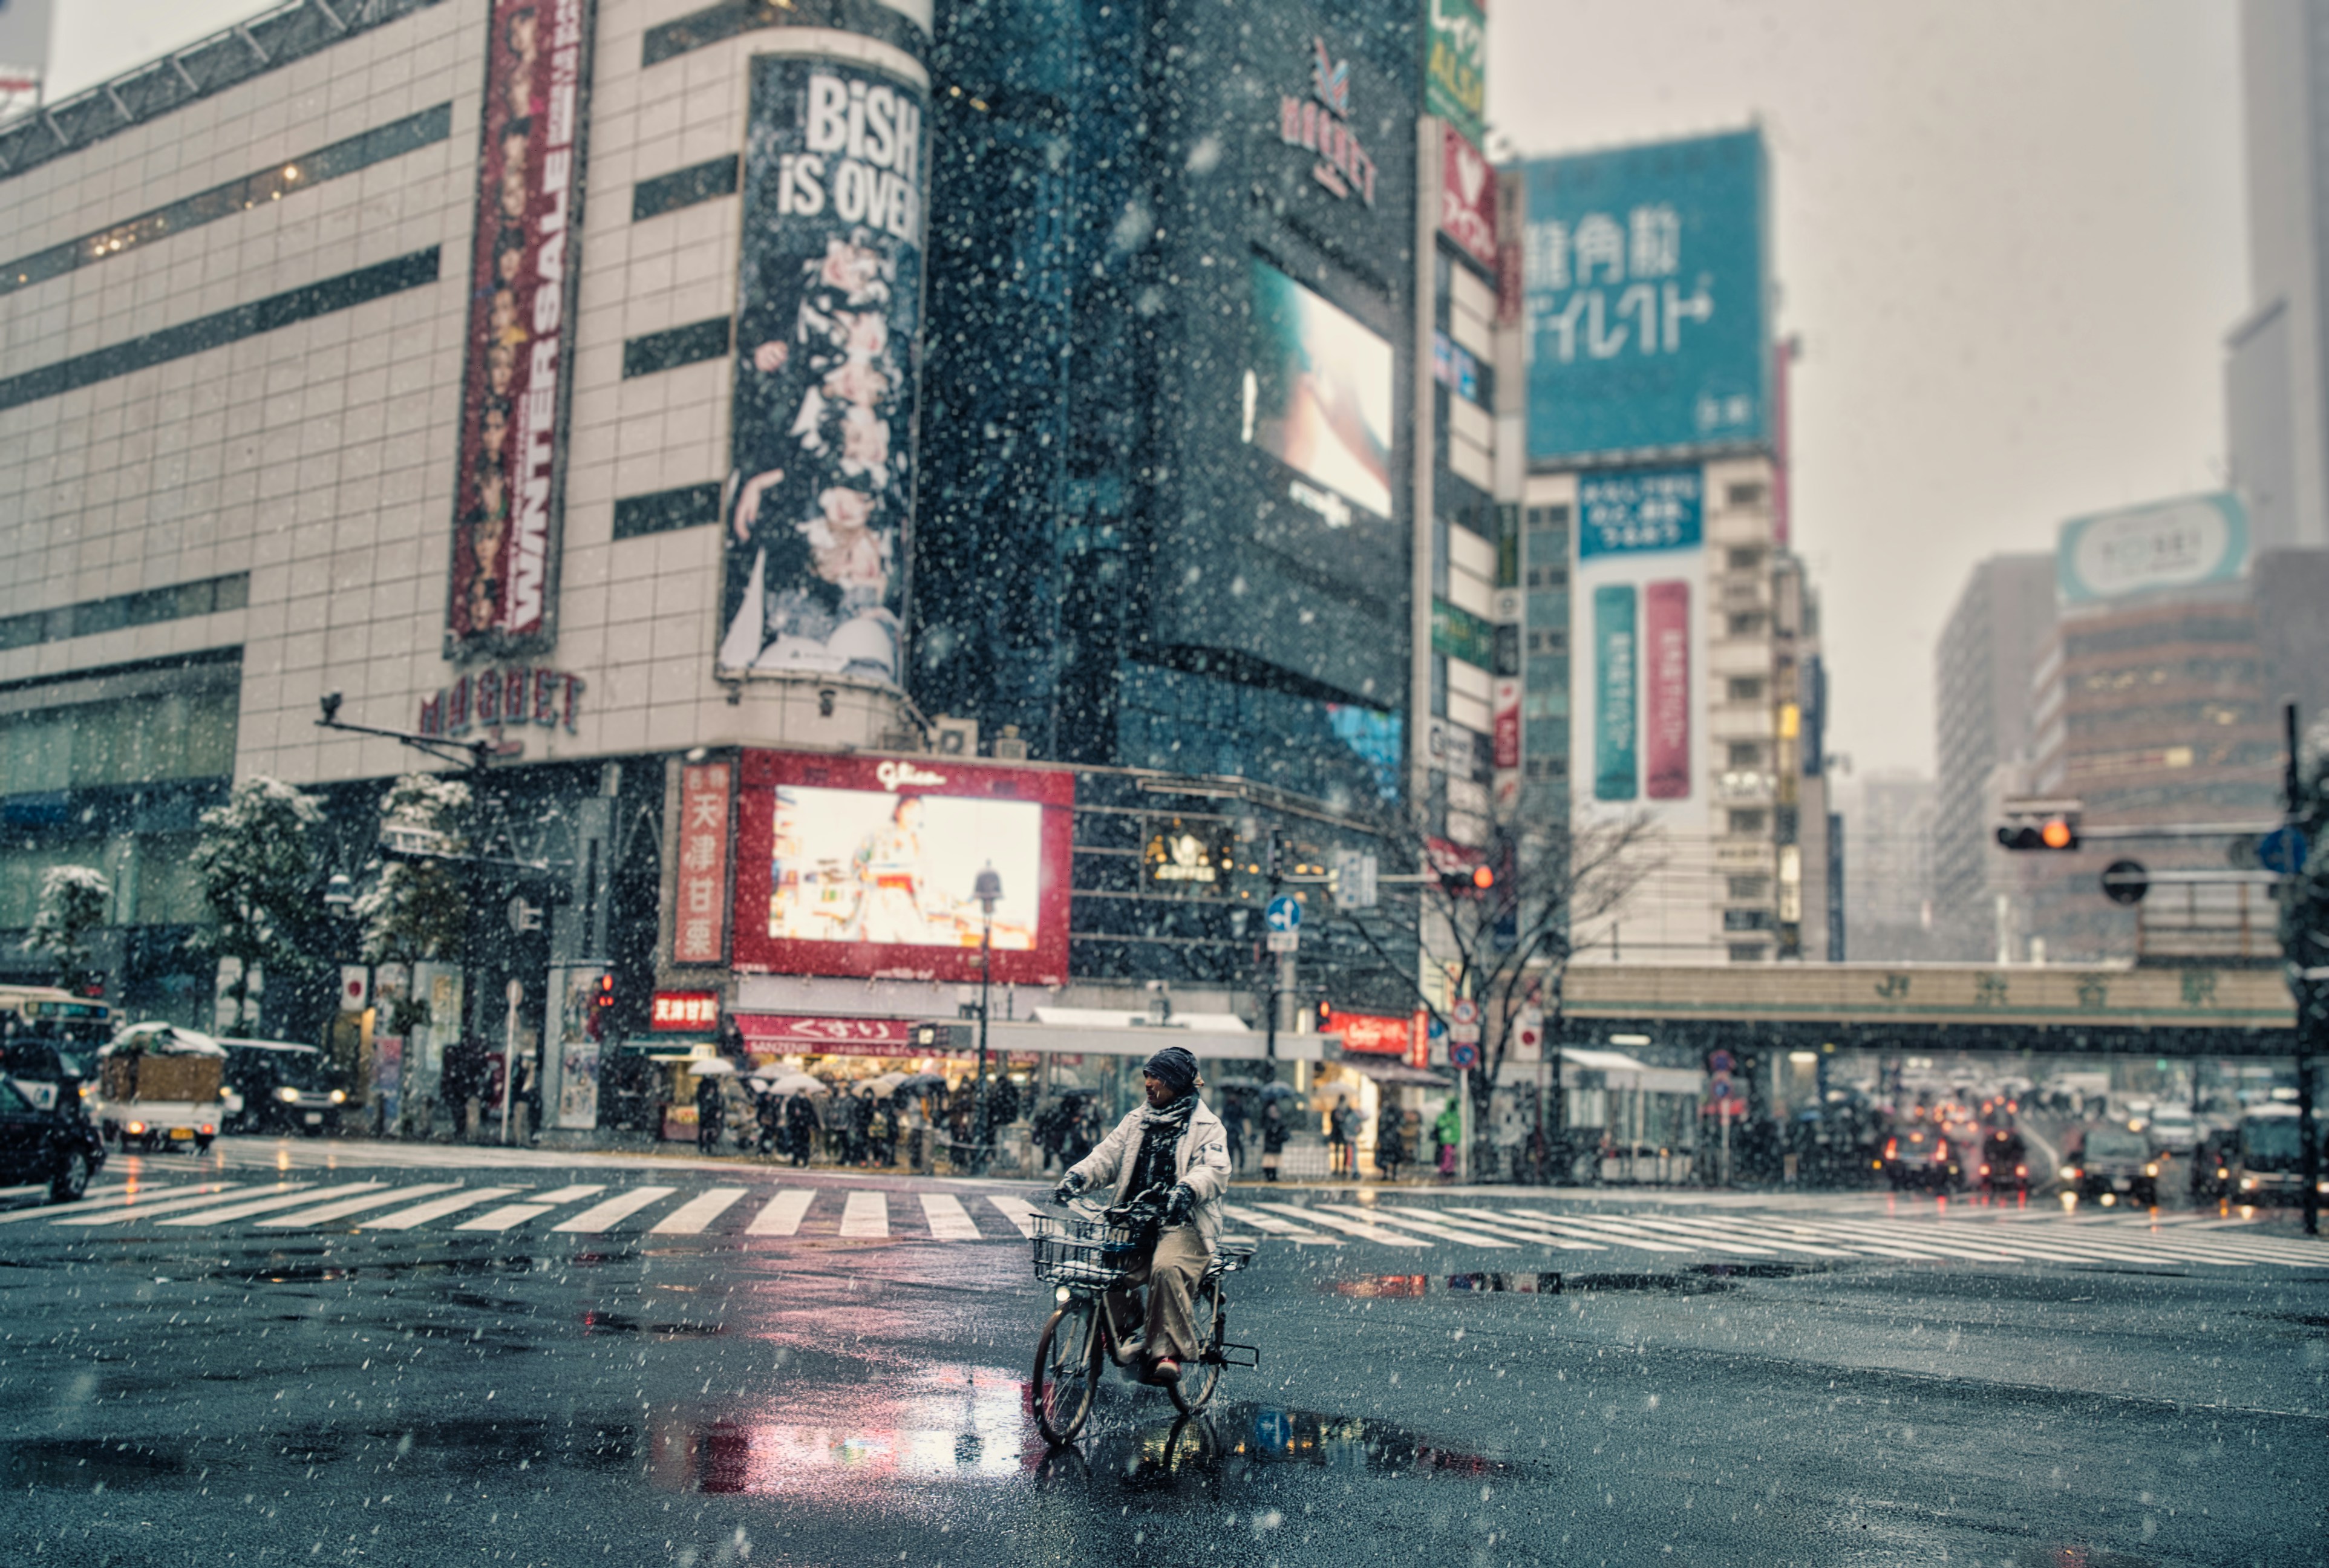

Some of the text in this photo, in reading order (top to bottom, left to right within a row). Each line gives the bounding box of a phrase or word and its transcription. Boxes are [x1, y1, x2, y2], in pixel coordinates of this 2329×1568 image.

[806, 73, 920, 184] BiSH
[778, 152, 825, 215] iS
[532, 149, 572, 336] SALE
[507, 336, 559, 632] WINTER
[419, 665, 585, 736] MAGNET
[877, 760, 947, 792] Glico
[684, 792, 719, 957] 天津甘栗
[790, 1019, 890, 1039] くすり
